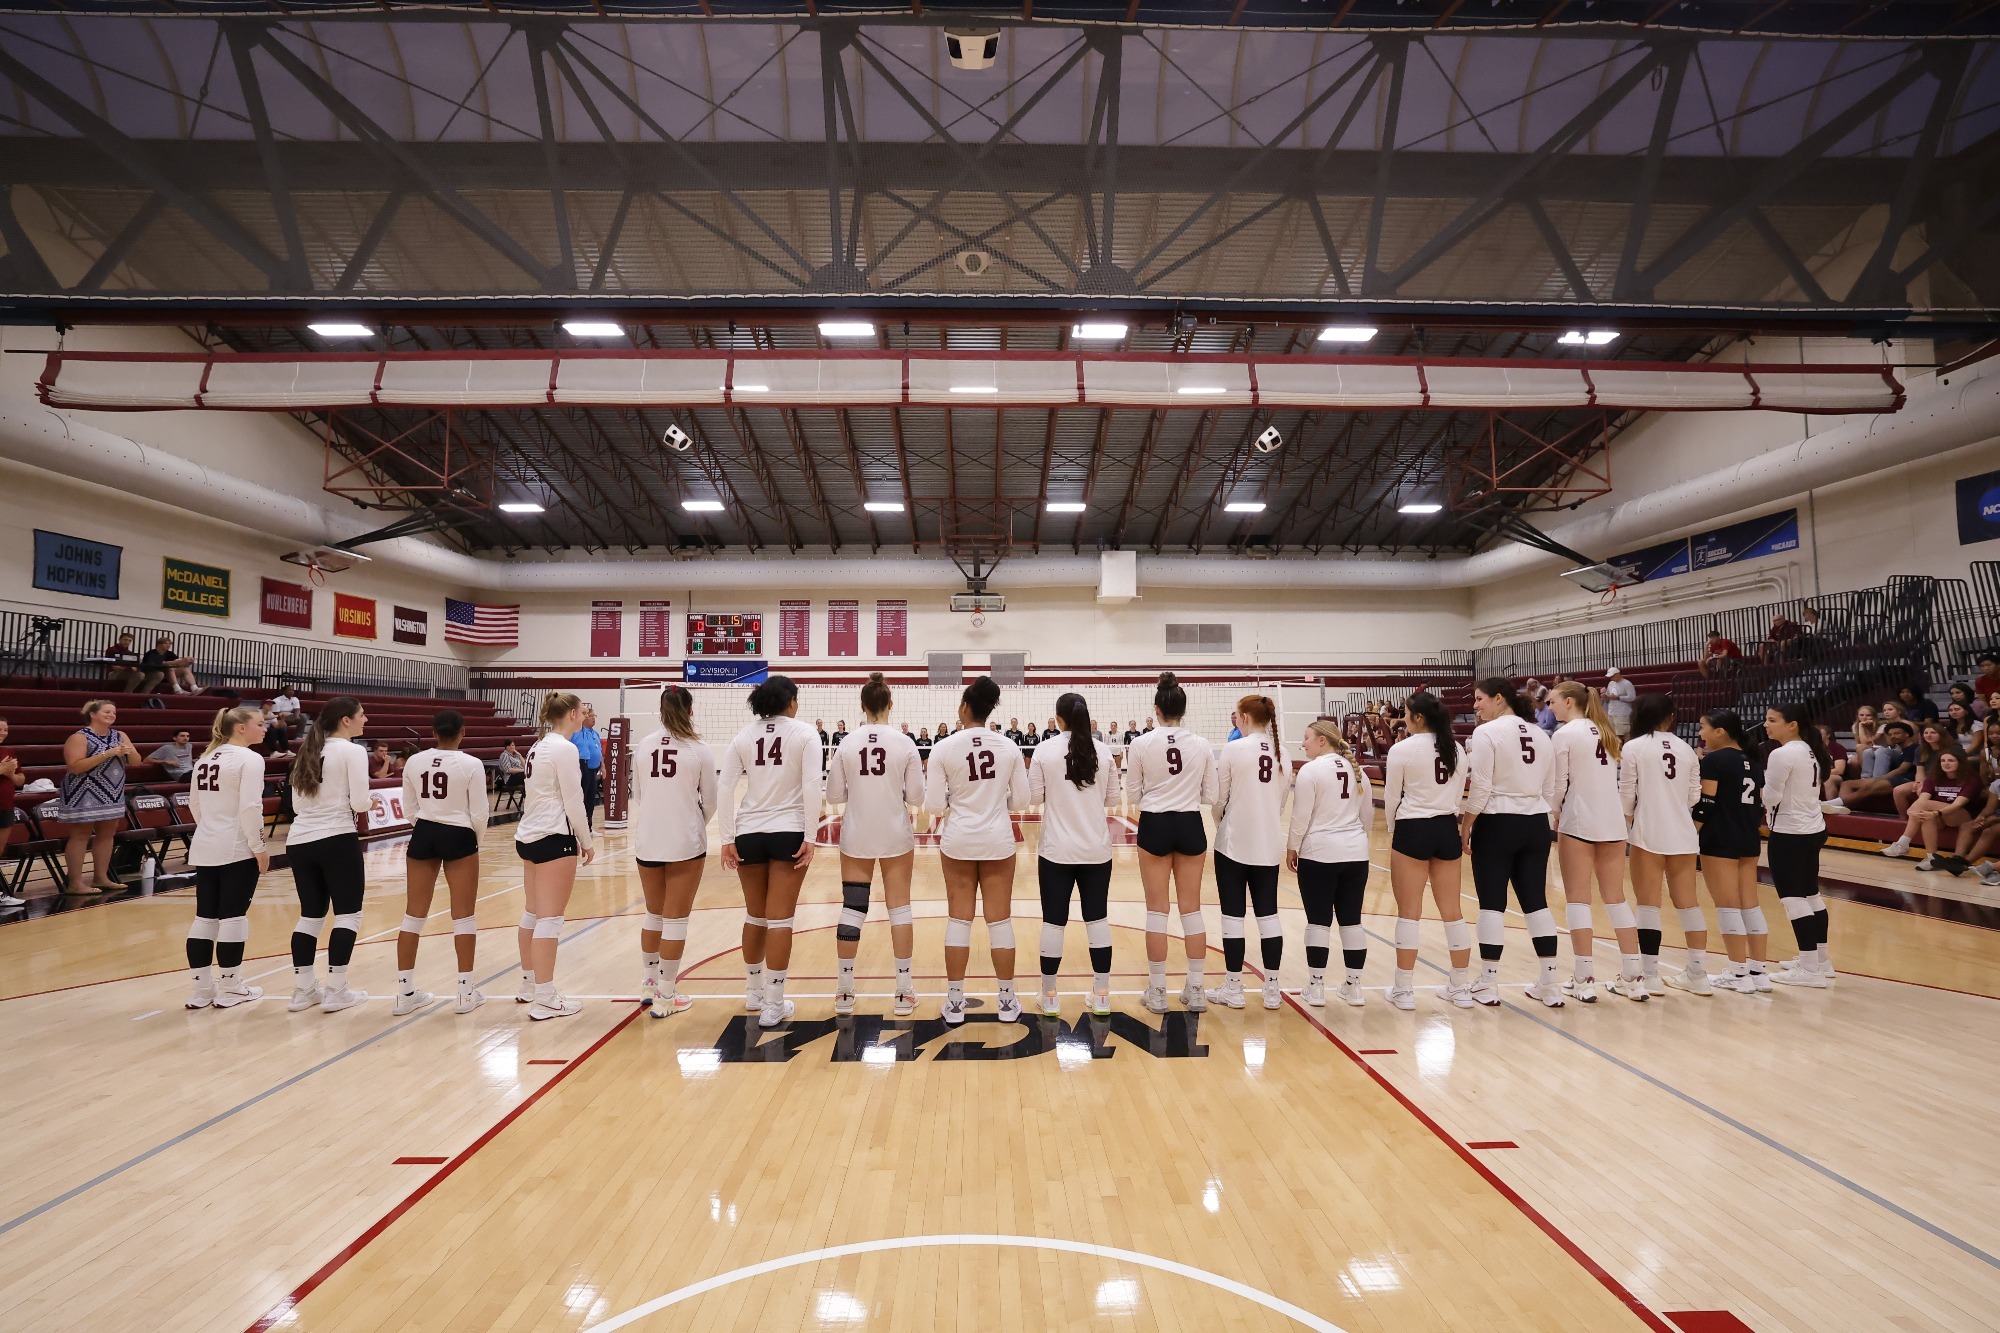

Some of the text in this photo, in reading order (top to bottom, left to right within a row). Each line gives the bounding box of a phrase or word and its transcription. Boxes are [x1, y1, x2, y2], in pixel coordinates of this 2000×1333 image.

[1982, 504, 2000, 515] NC
[55, 544, 103, 566] JOHNS
[47, 565, 106, 589] HOPKINS
[167, 568, 227, 590] McDANIEL
[168, 587, 225, 608] COLLEGE
[339, 608, 371, 626] URSINUS
[394, 617, 427, 635] WASHINGTON
[753, 621, 759, 631] 0
[610, 723, 621, 736] S
[765, 724, 775, 733] S
[869, 734, 878, 743] S
[1518, 725, 1527, 733] S
[1590, 727, 1599, 735] S
[661, 737, 671, 745] S
[972, 737, 982, 747] S
[1167, 735, 1176, 744] S
[1261, 743, 1269, 751] S
[1662, 741, 1670, 749] S
[211, 752, 221, 760] S
[755, 737, 783, 765] 14
[1519, 737, 1536, 764] 5
[1595, 739, 1609, 765] 4
[432, 758, 442, 767] S
[650, 749, 678, 777] 15
[859, 747, 886, 776] 13
[965, 750, 996, 782] 12
[1166, 748, 1183, 775] 9
[1258, 755, 1272, 783] 8
[1334, 760, 1344, 768] S
[1434, 757, 1449, 785] 6
[1662, 753, 1676, 779] 3
[1743, 761, 1751, 770] S
[197, 763, 220, 791] 22
[420, 771, 448, 799] 19
[609, 742, 619, 817] SWARTHMORE
[1336, 772, 1350, 799] 7
[1811, 762, 1818, 788] 1
[1741, 777, 1756, 805] 2
[137, 801, 165, 809] GARNET
[621, 811, 627, 819] S
[715, 1010, 1210, 1063] NCAA
